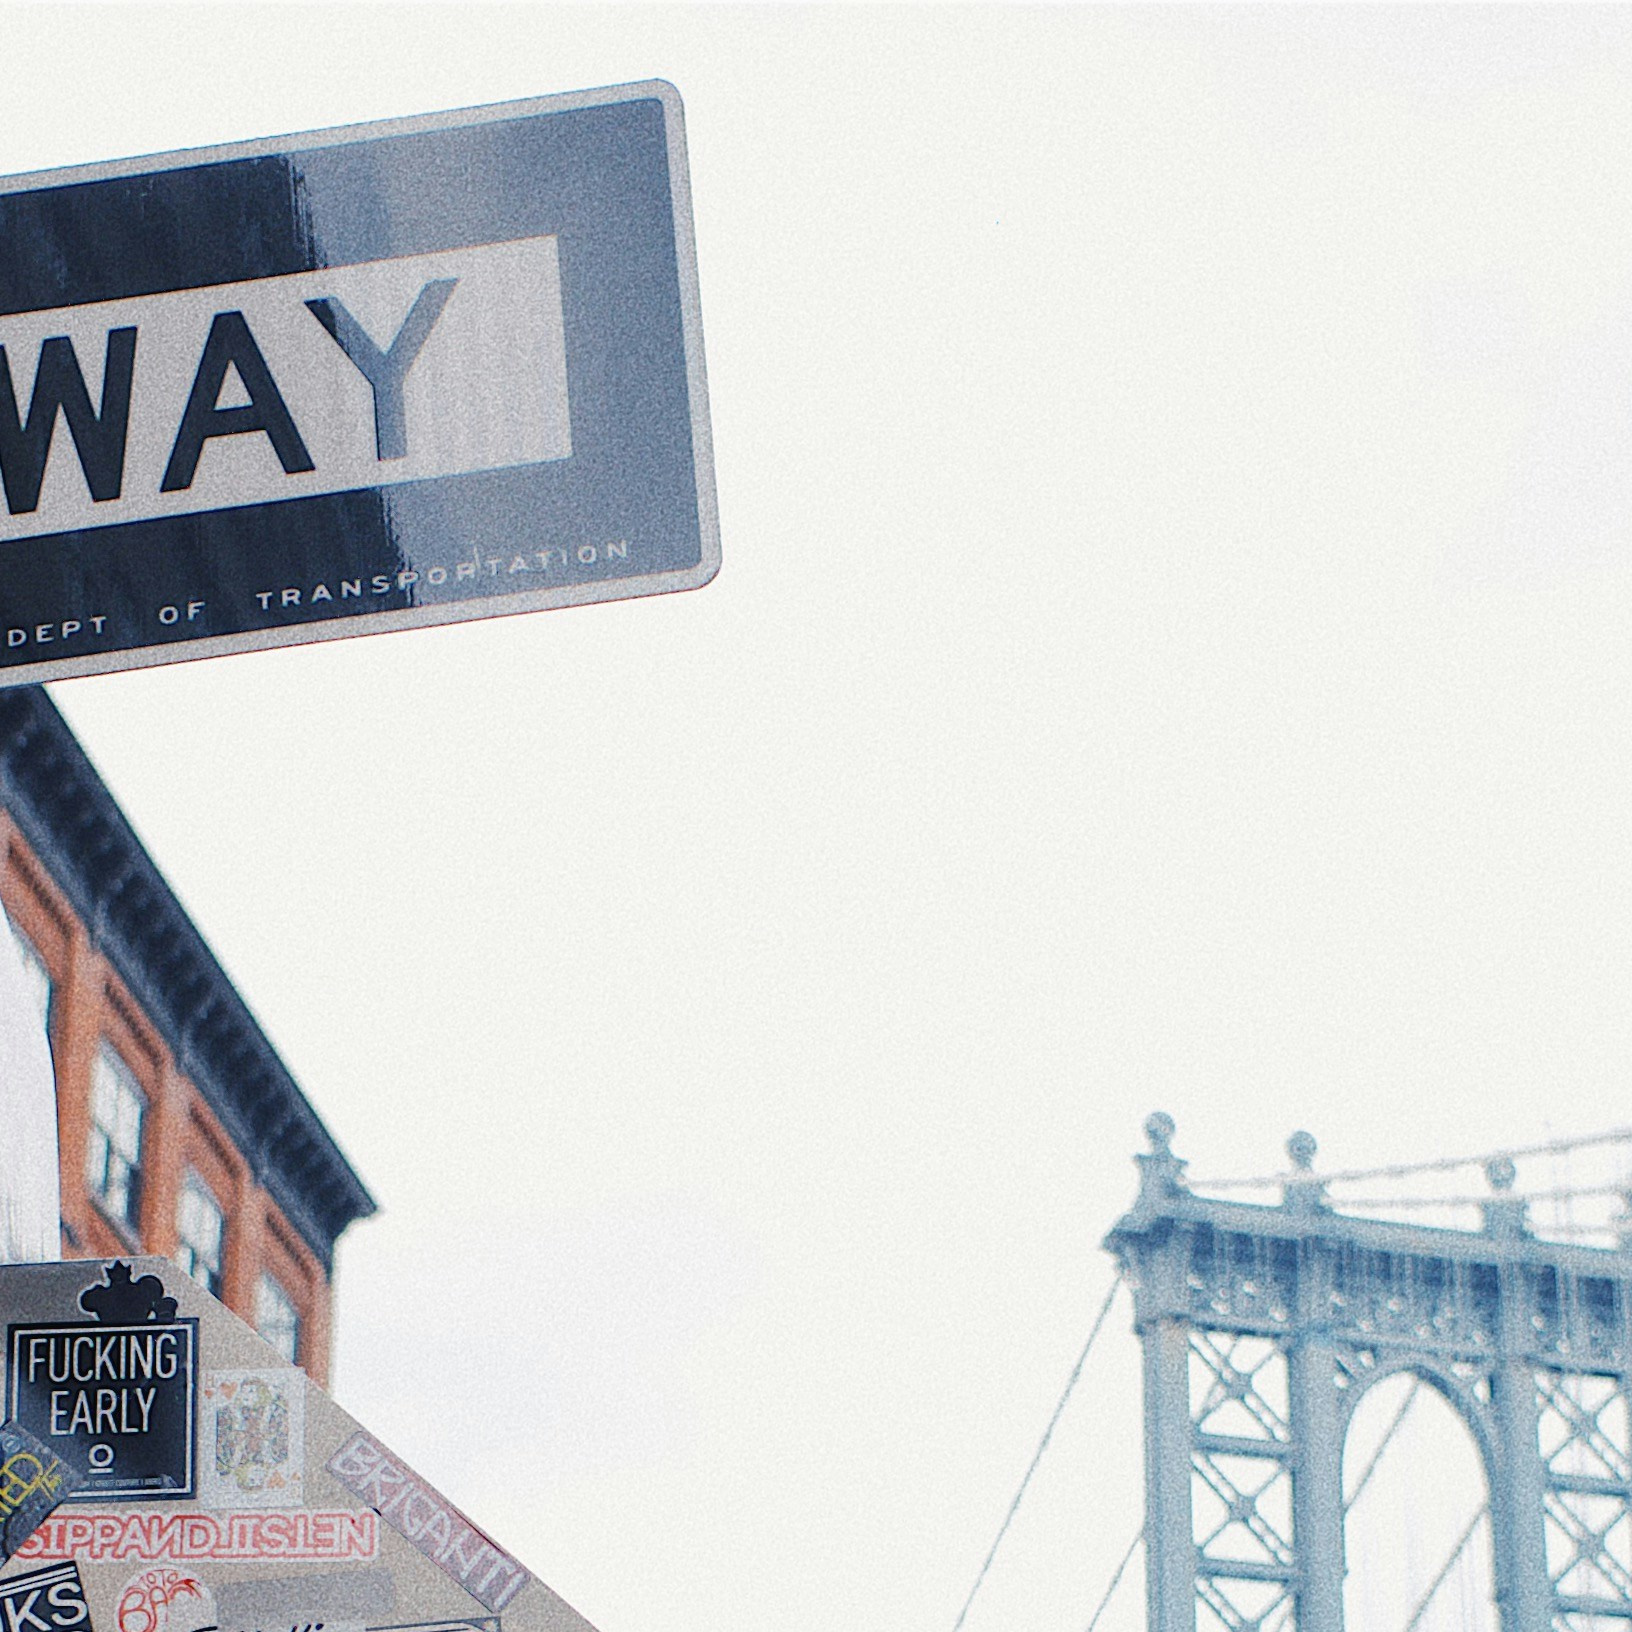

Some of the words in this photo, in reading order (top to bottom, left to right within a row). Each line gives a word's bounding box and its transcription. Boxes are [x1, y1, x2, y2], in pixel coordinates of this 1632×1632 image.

[7, 616, 108, 648] DEPT
[158, 601, 206, 625] OF
[255, 539, 629, 611] TRANSPORTATION
[28, 1332, 179, 1384] FUCKING
[49, 1387, 157, 1437] EARLY
[331, 1437, 526, 1609] BRIGANTI
